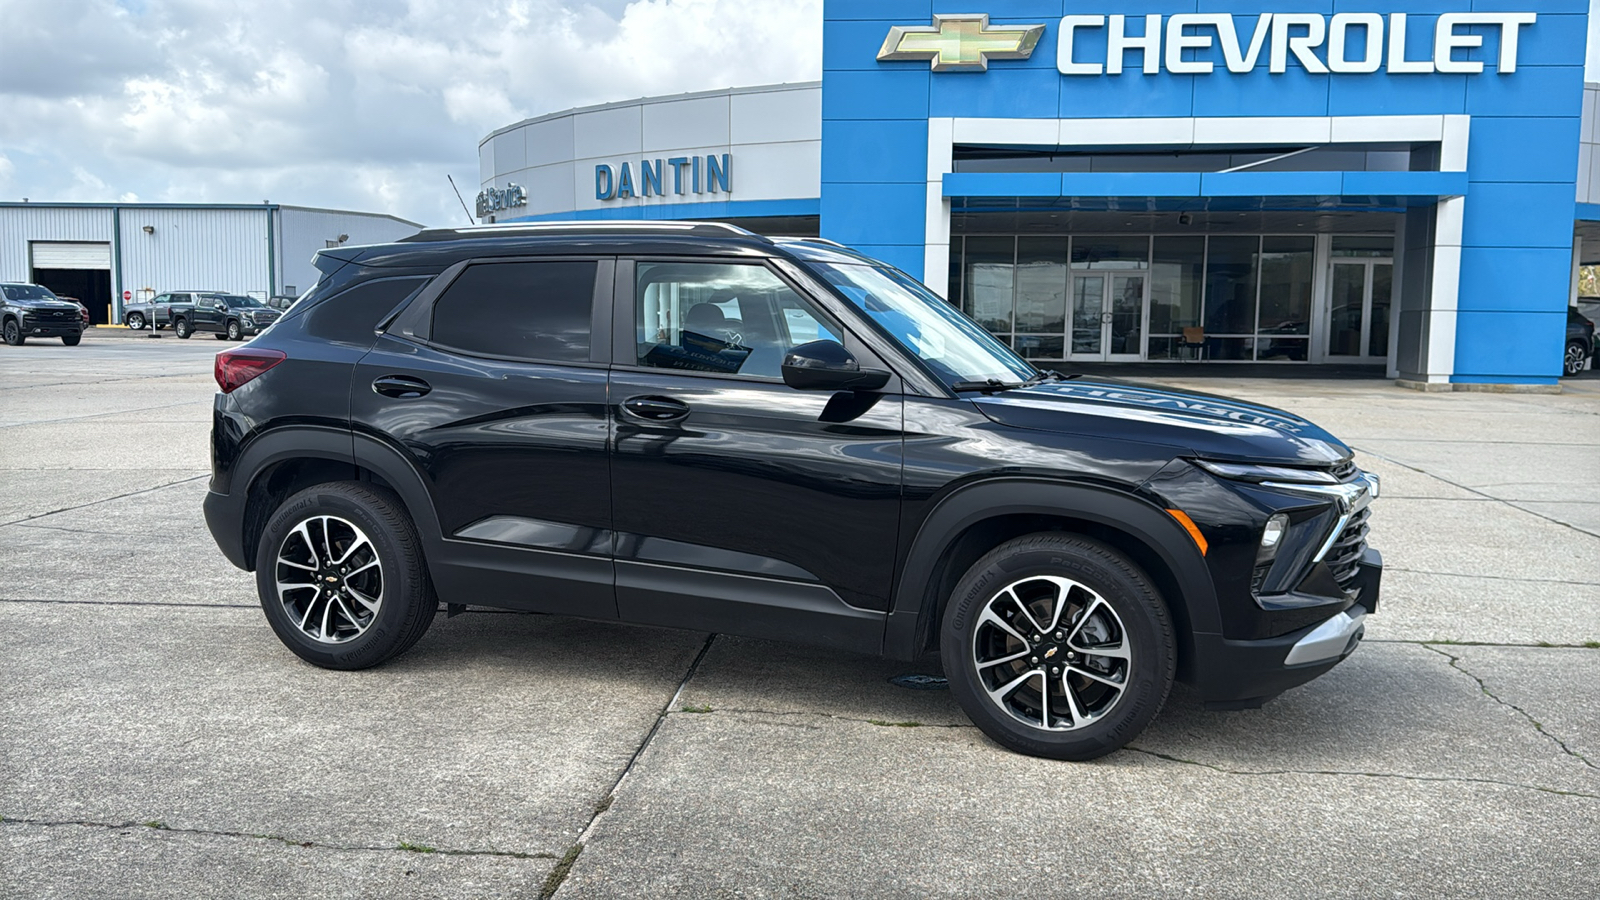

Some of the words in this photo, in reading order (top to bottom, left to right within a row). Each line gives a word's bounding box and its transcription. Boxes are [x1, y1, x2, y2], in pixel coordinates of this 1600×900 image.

[1056, 12, 1538, 75] CHEVROLET
[489, 182, 527, 211] Service
[595, 153, 733, 202] DANTIN
[953, 575, 990, 632] Continental
